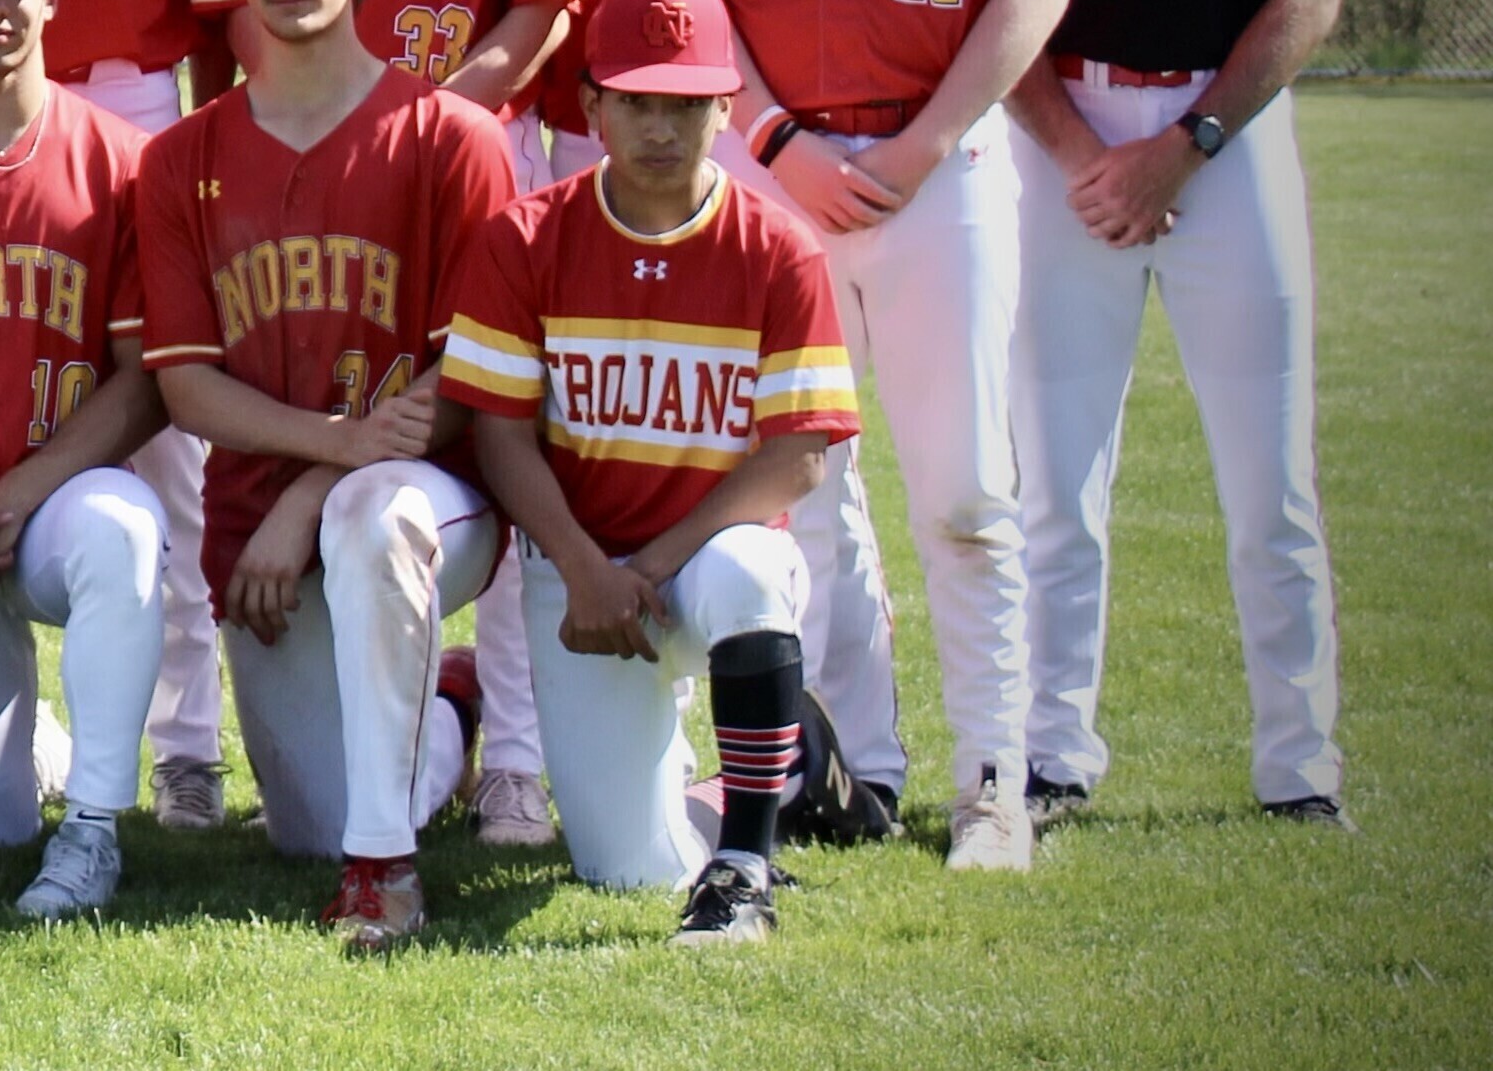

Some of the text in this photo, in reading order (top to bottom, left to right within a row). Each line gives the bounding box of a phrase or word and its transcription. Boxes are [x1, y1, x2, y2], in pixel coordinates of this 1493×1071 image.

[389, 3, 475, 85] 33
[213, 234, 401, 349] NORTH
[27, 359, 97, 446] 10
